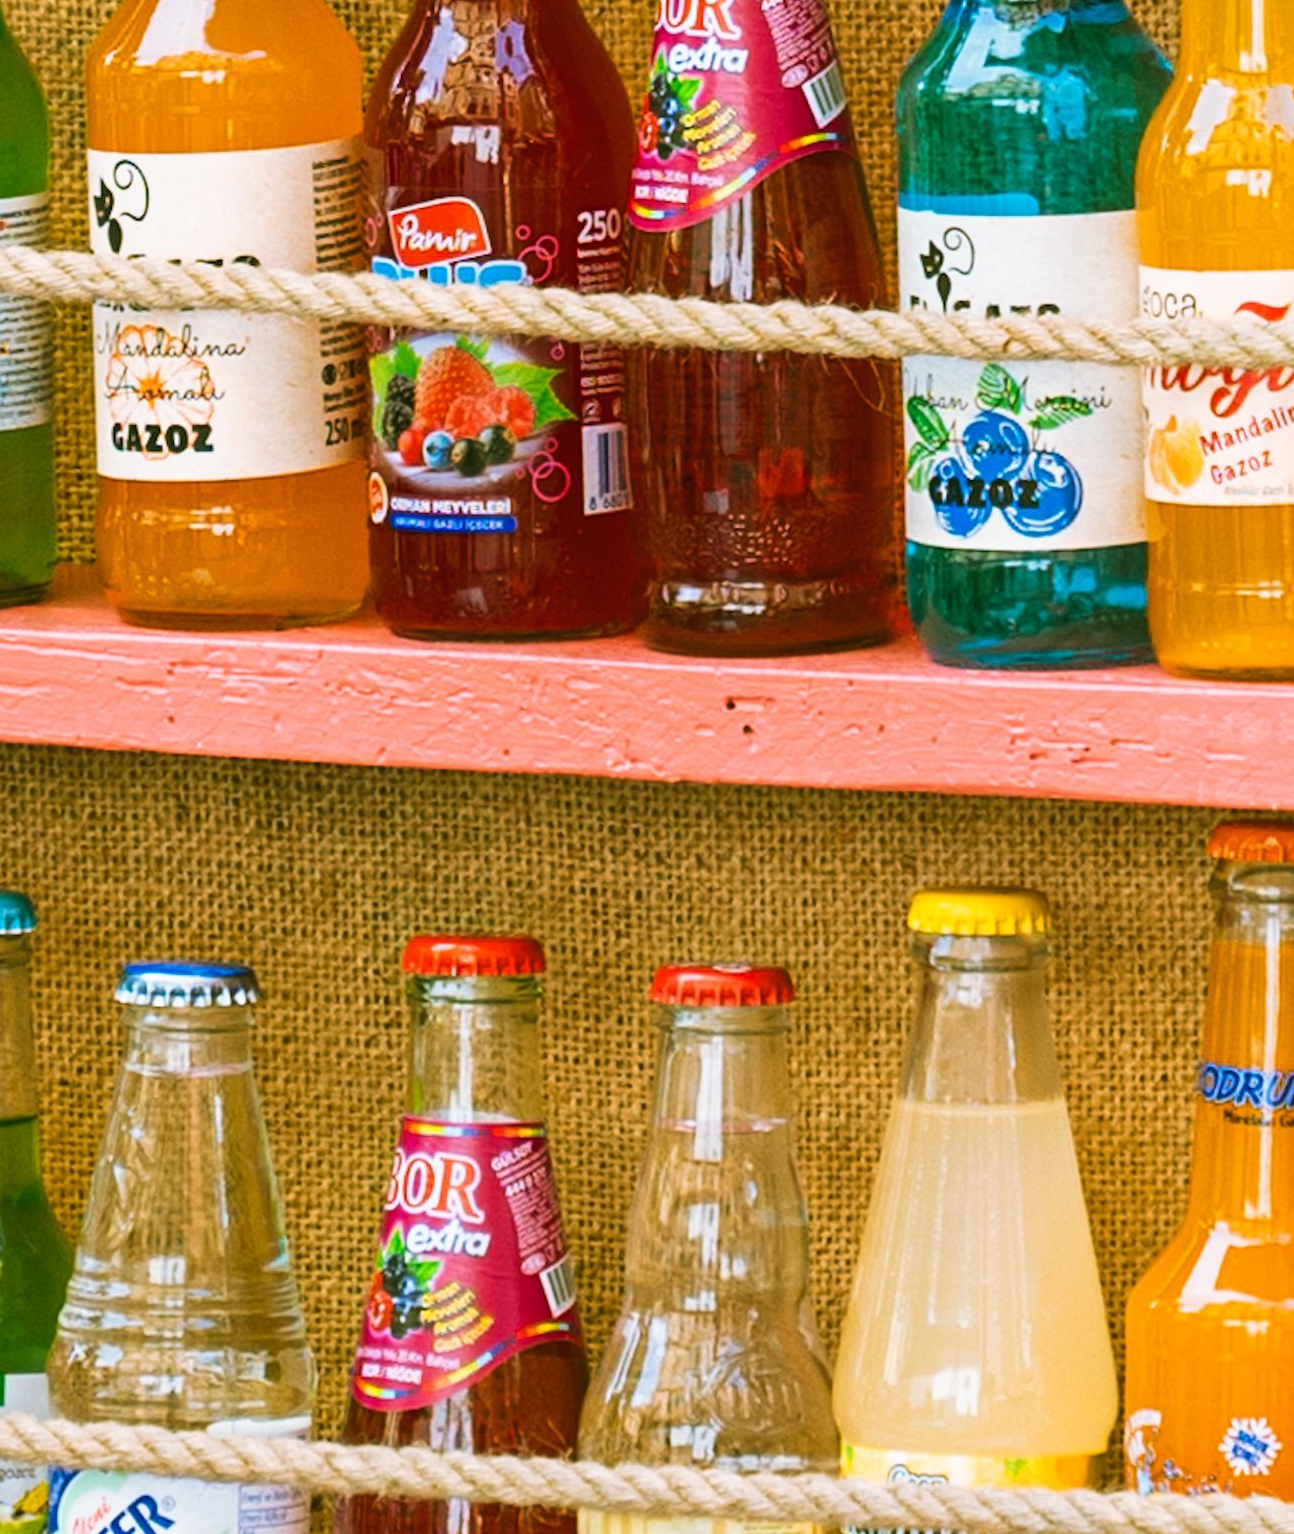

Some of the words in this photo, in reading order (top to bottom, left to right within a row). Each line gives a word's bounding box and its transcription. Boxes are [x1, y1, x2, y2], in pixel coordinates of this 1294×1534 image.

[668, 37, 749, 73] extra
[397, 213, 477, 251] Pamir
[577, 207, 621, 244] 250
[97, 322, 248, 359] Mandalina
[111, 421, 215, 453] GAZOZ
[1210, 449, 1274, 485] Gazoz
[434, 498, 511, 515] MEYVELERİ
[406, 1220, 491, 1258] extra
